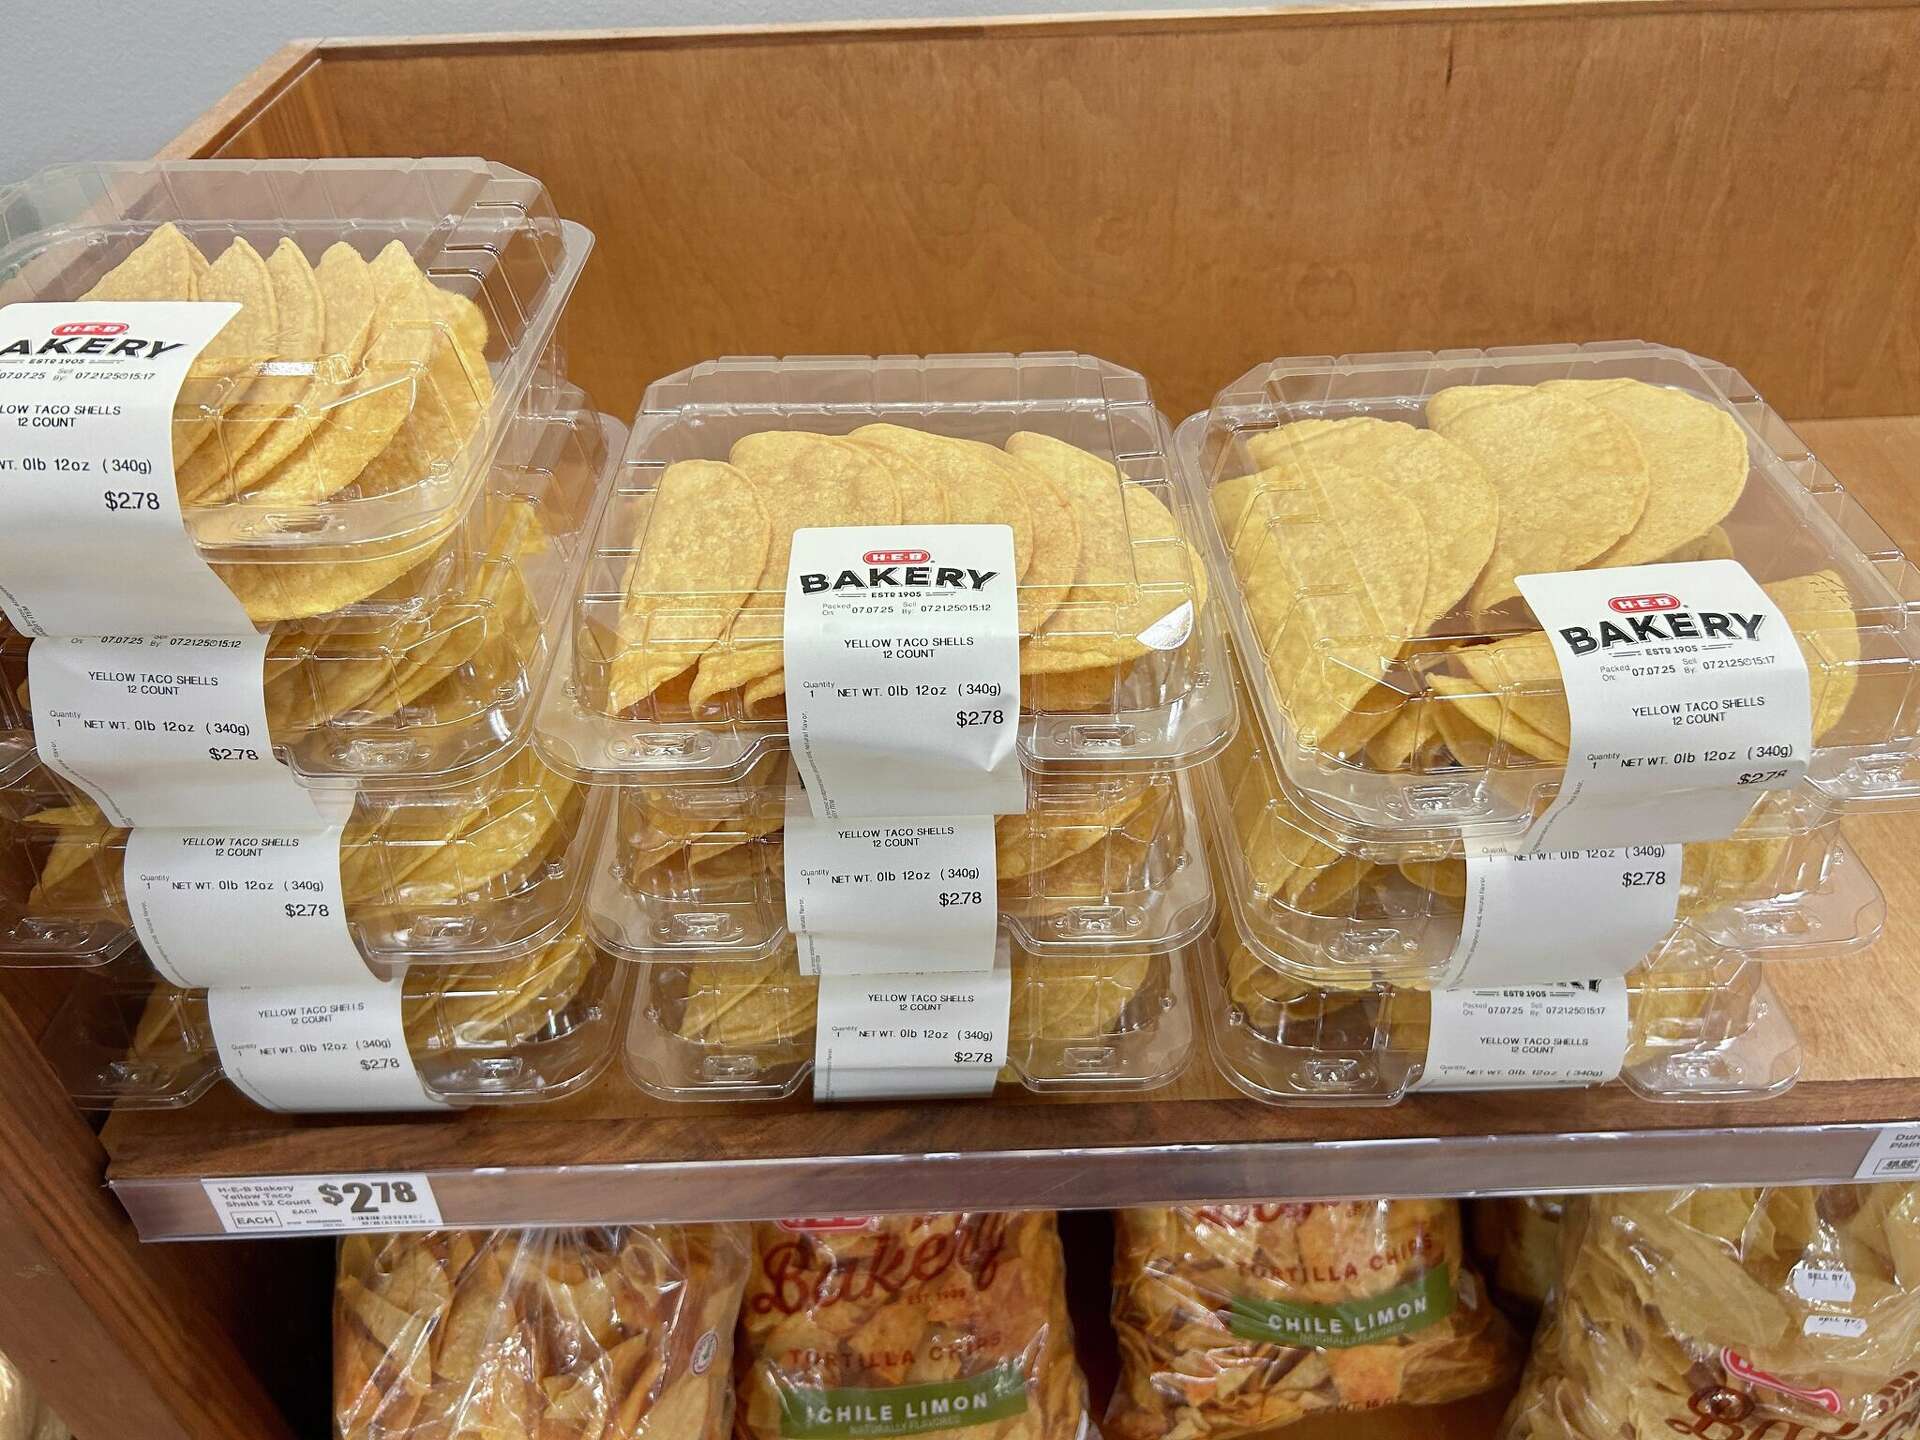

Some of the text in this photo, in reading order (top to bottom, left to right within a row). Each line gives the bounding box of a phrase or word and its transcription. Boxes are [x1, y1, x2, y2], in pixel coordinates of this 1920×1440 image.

[35, 406, 69, 415] TACO
[75, 406, 121, 415] SHELLS
[18, 418, 76, 427] 12 COUNT
[54, 459, 90, 471] 12oz
[105, 491, 160, 511] $2.78
[800, 567, 1001, 594] BAKERY
[1559, 612, 1766, 656] BAKERY
[844, 637, 974, 648] YELLOW TACO SHELLS
[883, 649, 935, 659] 12 COUNT
[1674, 645, 1698, 654] 1905
[1600, 664, 1630, 673] Packed
[89, 672, 218, 685] YELLOW TACO SHELLS
[127, 685, 180, 695] 12 COUNT
[803, 681, 835, 689] Quantity
[837, 689, 857, 697] NET
[863, 688, 882, 697] WT.
[888, 687, 909, 696] 0lb
[915, 685, 947, 696] 12oz
[1632, 696, 1765, 717] YELLOW TACO SHELLS
[50, 711, 81, 719] Quantity
[956, 710, 1004, 728] $2.78
[1672, 712, 1726, 726] 12 COUNT
[84, 720, 104, 729] NET
[111, 722, 130, 730] WT.
[135, 721, 155, 730] 0lb
[163, 722, 195, 732] 12oz
[209, 748, 258, 760] $2.78
[1587, 752, 1620, 762] Quantity
[1621, 758, 1644, 768] NET
[1648, 756, 1668, 766] WT.
[1674, 753, 1696, 764] 0lb
[1704, 751, 1736, 762] 12oz
[838, 827, 954, 839] YELLOW TACO SHELLS
[182, 838, 225, 846] YELLOW
[872, 838, 920, 848] 12 COUNT
[216, 848, 262, 856] 12 COUNT
[141, 874, 170, 882] Quantity
[832, 875, 850, 884] NET
[854, 874, 872, 883] WT.
[877, 872, 896, 882] 0lb
[902, 871, 930, 880] 12oz
[1622, 871, 1665, 887] $2.78
[172, 882, 191, 890] NET
[195, 881, 214, 890] WT.
[218, 881, 238, 890] 0lb
[245, 881, 274, 890] 12oz
[939, 891, 982, 907] $2.78
[285, 904, 329, 917] $2.78
[868, 994, 907, 1002] YELLOW
[911, 994, 937, 1002] TACO
[258, 1008, 296, 1019] YELLOW
[301, 1006, 327, 1014] TACO
[301, 1015, 332, 1024] COUNT
[901, 1029, 917, 1038] 0lb
[923, 1030, 948, 1039] 12oz
[1480, 1037, 1589, 1046] YELLOW TACO SHELLS
[260, 1047, 276, 1055] NET
[322, 1042, 347, 1052] 12oz
[1522, 1046, 1554, 1054] COUNT
[954, 1052, 993, 1063] $2.78
[255, 1185, 294, 1193] Bakery
[237, 1216, 274, 1225] EACH
[1370, 1236, 1433, 1271] CHIPS
[1269, 1296, 1427, 1334] CHILE LIMON
[818, 1392, 988, 1423] CHILE LIMON
